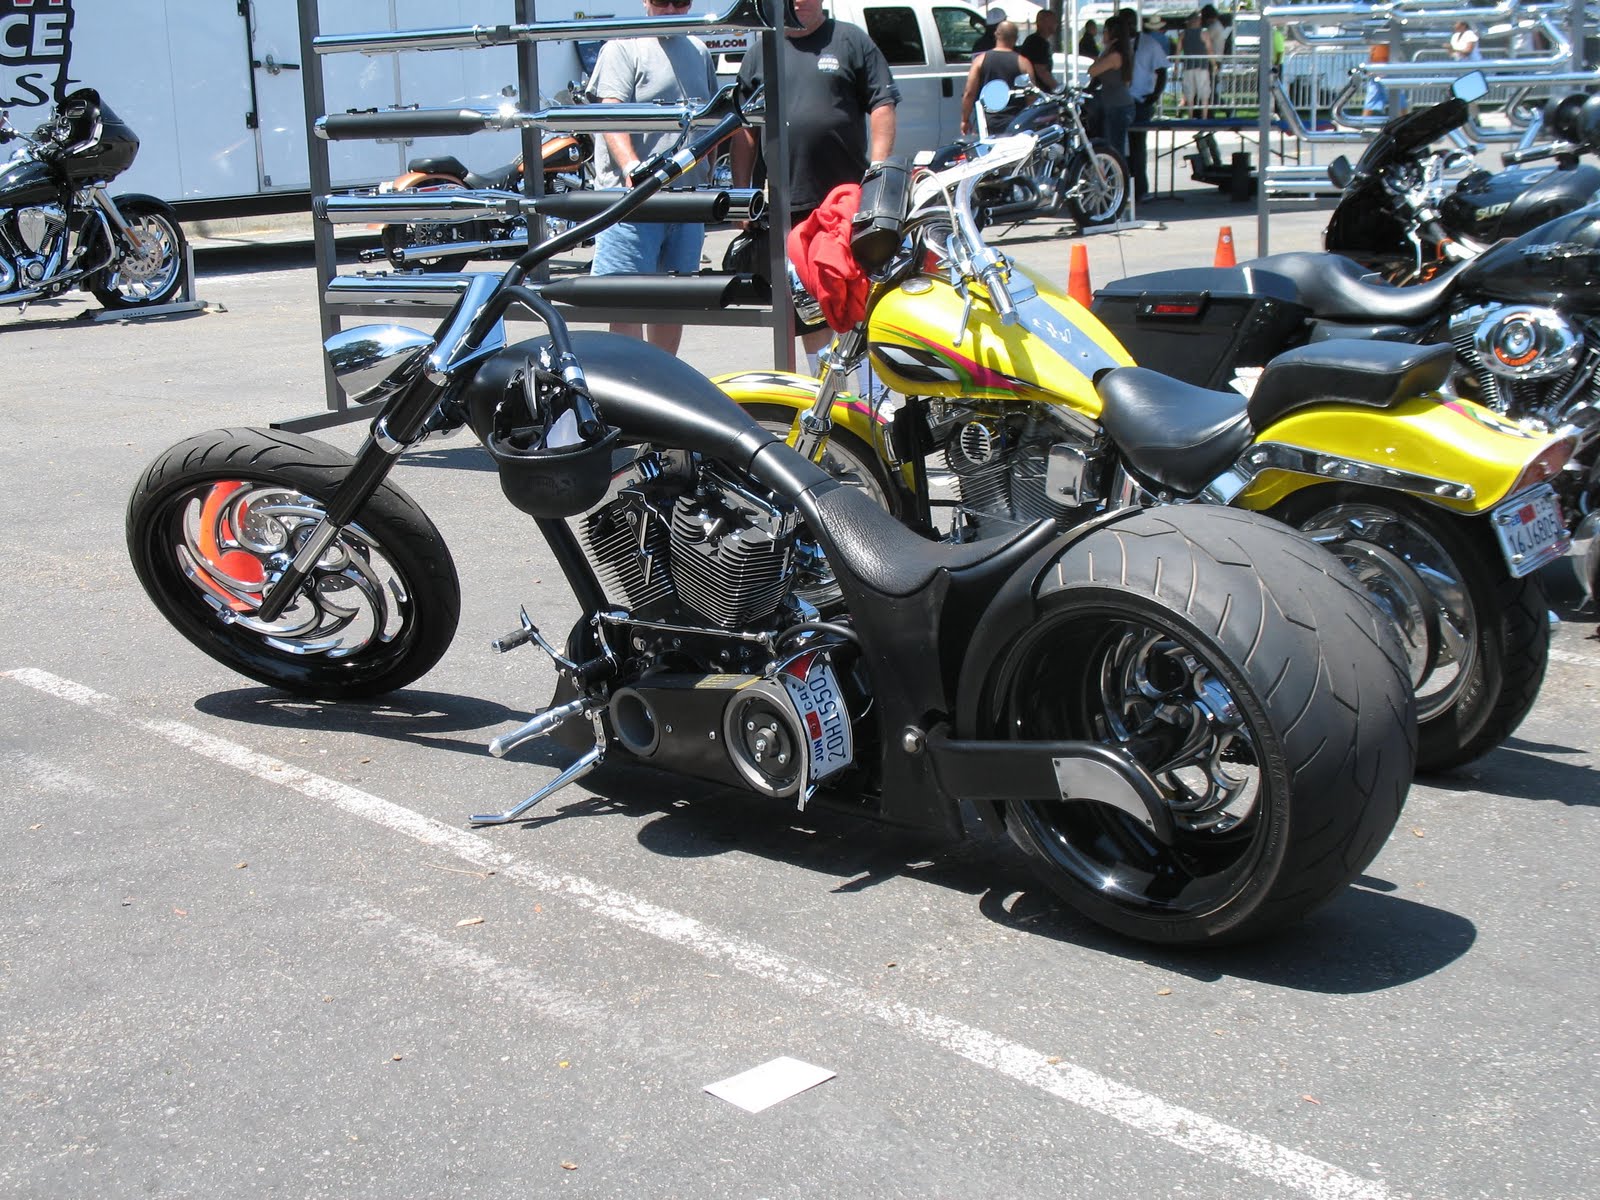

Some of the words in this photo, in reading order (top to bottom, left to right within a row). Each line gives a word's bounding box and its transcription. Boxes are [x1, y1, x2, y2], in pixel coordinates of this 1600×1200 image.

[0, 13, 67, 58] CE
[809, 677, 845, 763] 20H1550
[813, 740, 823, 761] JUN
